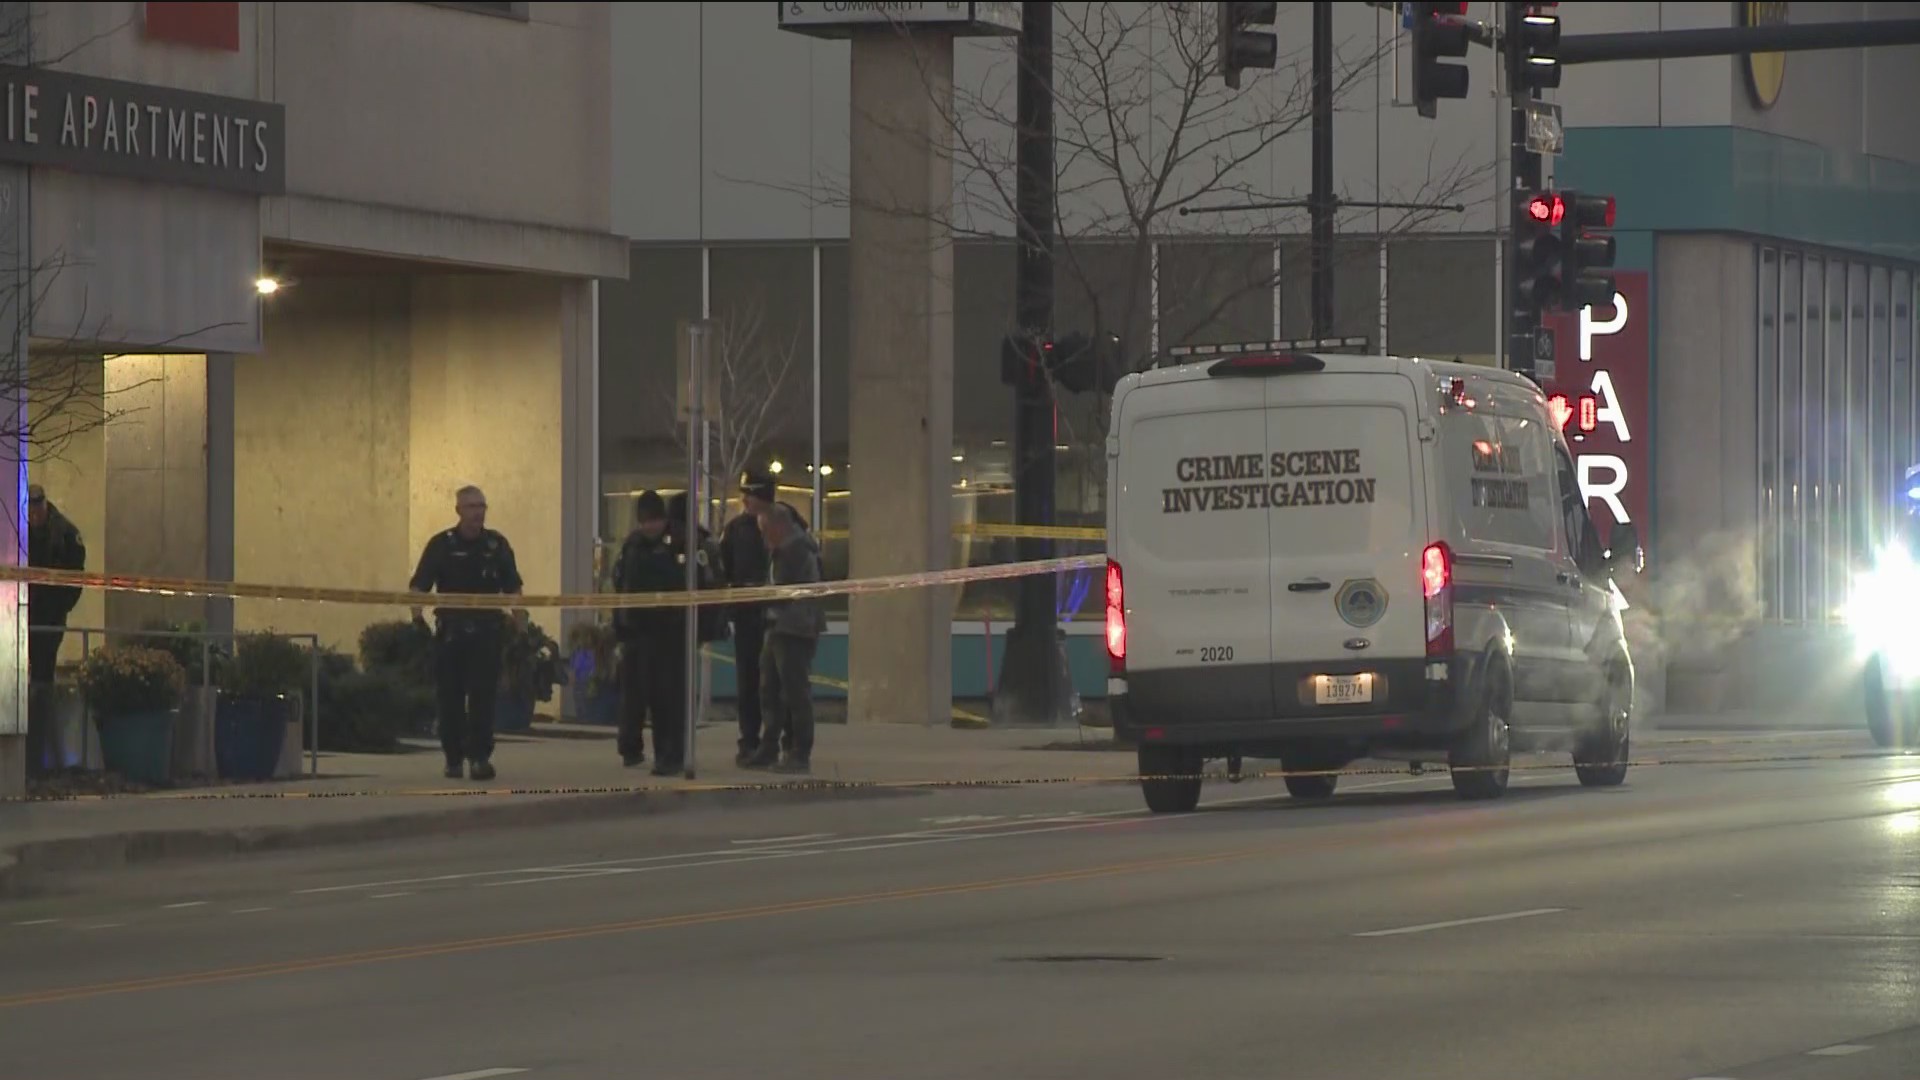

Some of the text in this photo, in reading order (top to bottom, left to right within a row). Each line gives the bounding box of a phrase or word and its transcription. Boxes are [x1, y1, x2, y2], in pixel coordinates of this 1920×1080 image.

[8, 82, 268, 172] IE APARTMENTS
[1177, 449, 1361, 482] CRIME SCENE
[1162, 478, 1376, 513] INVESTIGATION
[1200, 646, 1234, 662] 2020
